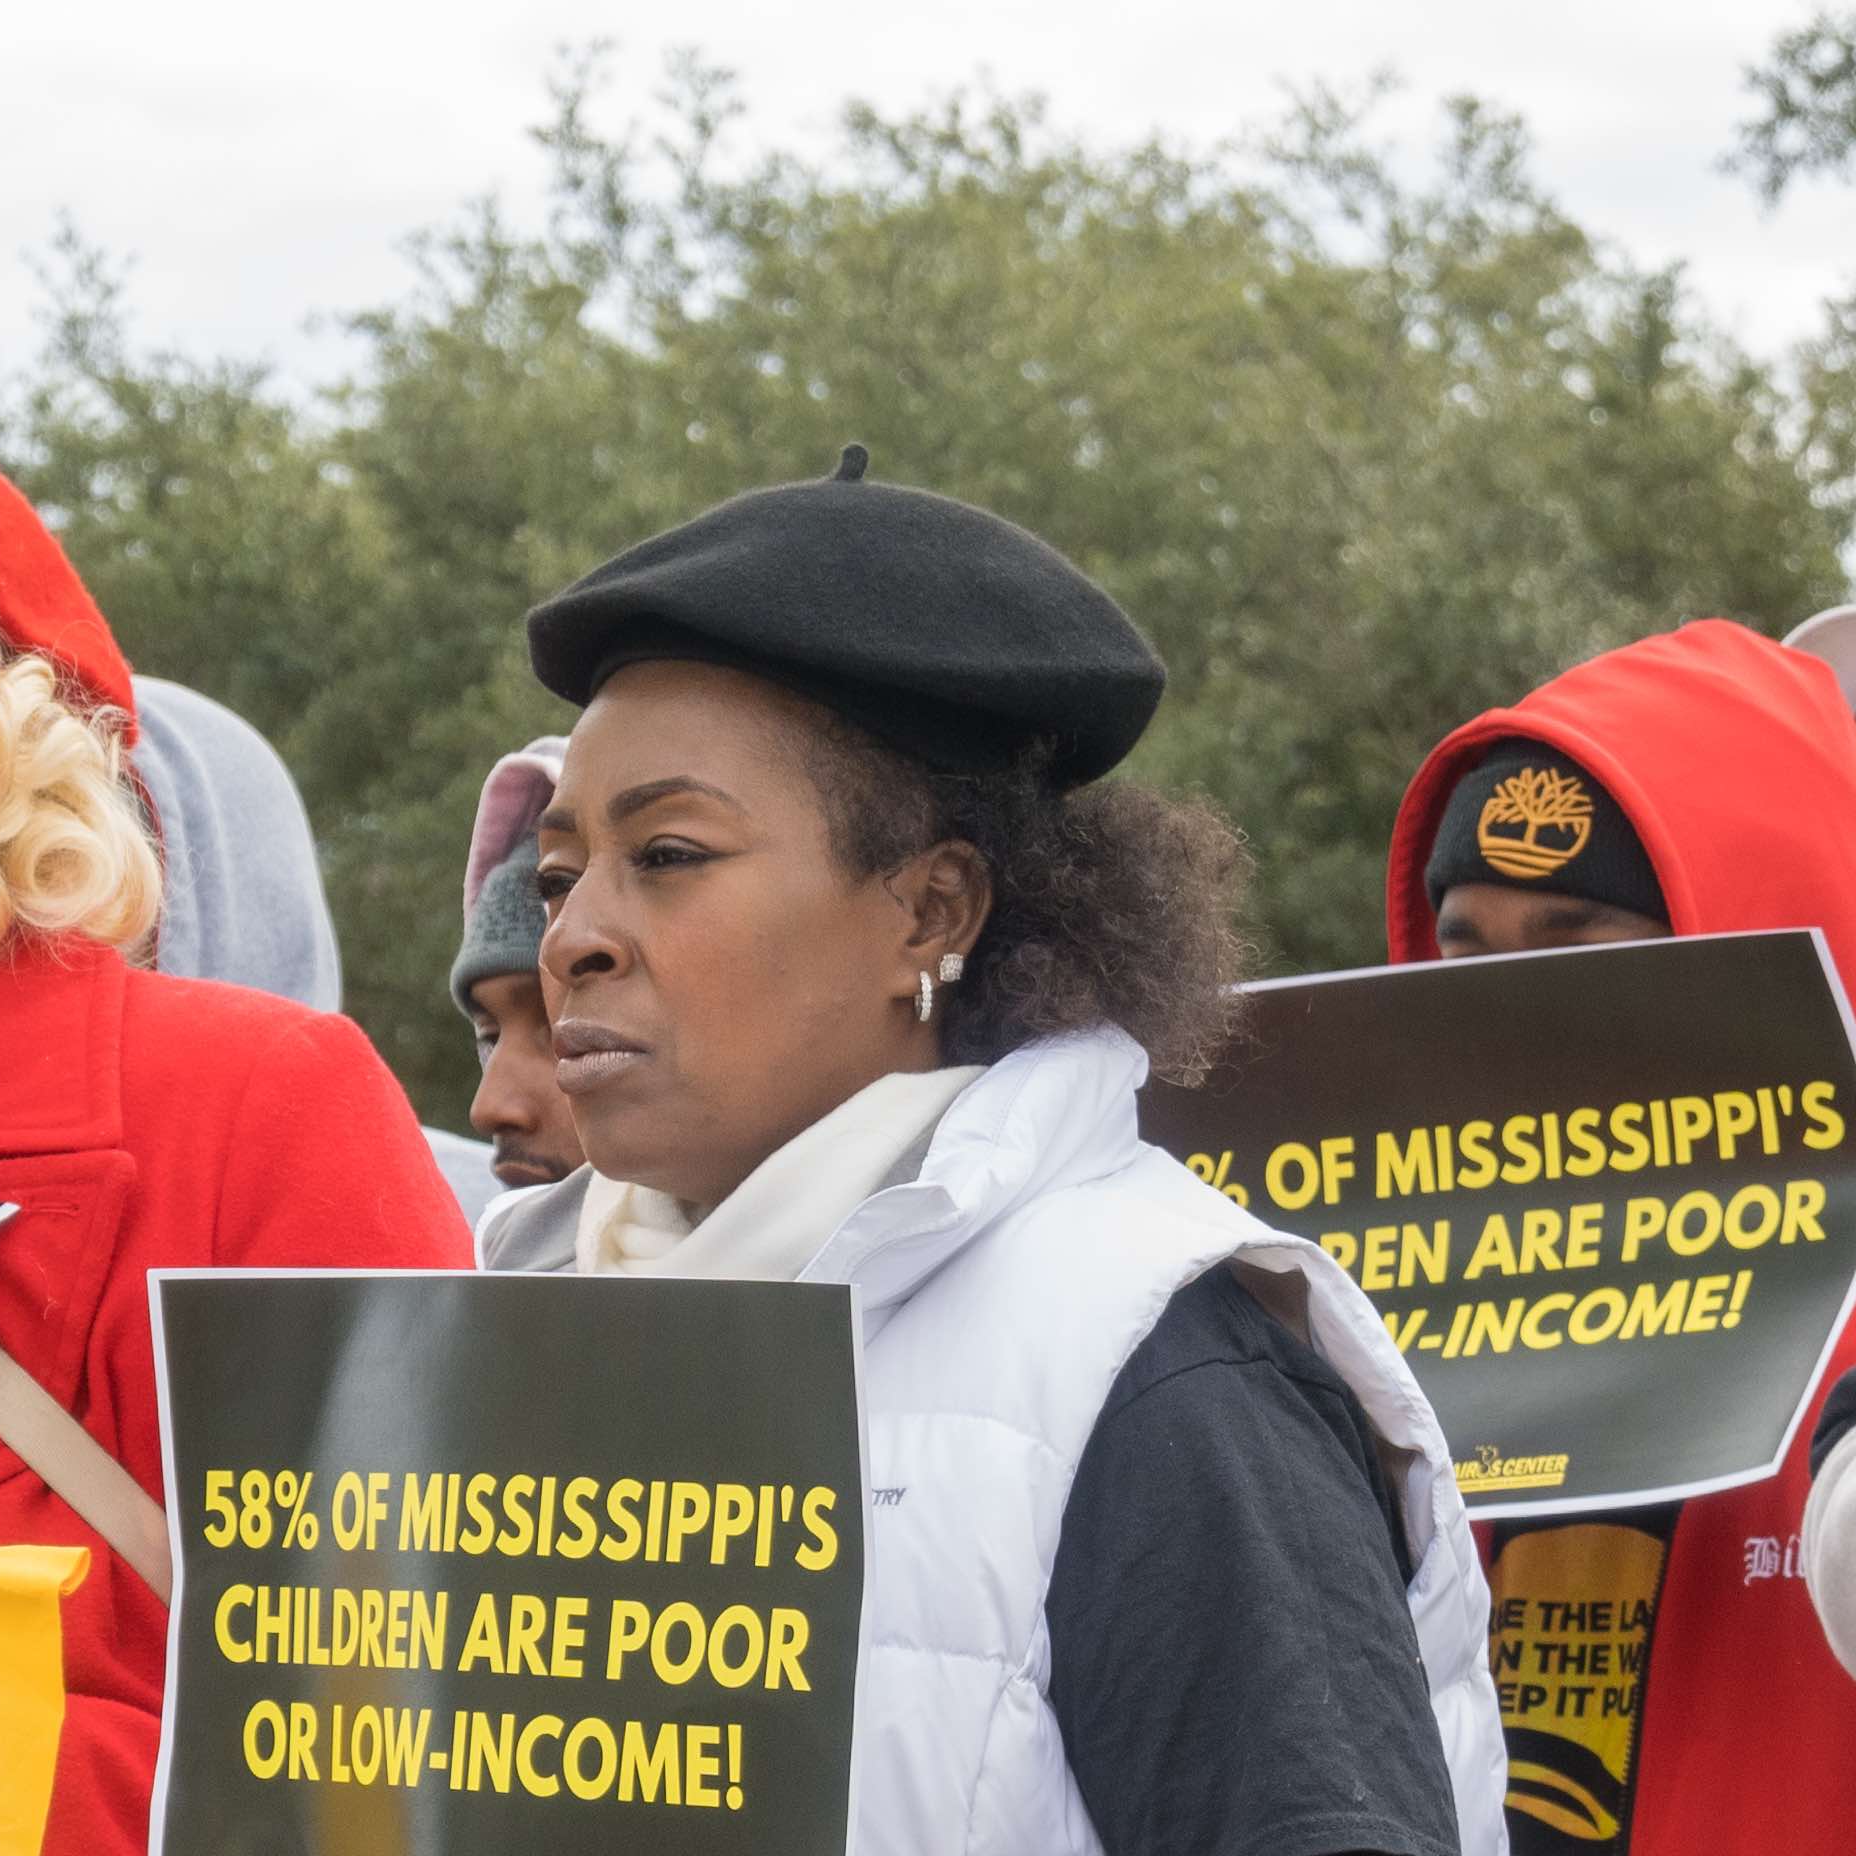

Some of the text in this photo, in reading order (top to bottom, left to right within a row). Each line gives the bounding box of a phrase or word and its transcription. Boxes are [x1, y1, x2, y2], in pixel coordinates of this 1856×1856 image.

[1265, 1136, 1356, 1210] OF
[1375, 1081, 1846, 1199] MISSISSIPPI'S
[1463, 1201, 1602, 1280] ARE
[1620, 1180, 1827, 1263] POOR
[1503, 1453, 1570, 1476] CENTER
[202, 1469, 839, 1571] 58% OF MISSISSIPPI'S
[214, 1584, 812, 1692] CHILDREN ARE POOR
[1533, 1641, 1611, 1675] THE
[1537, 1600, 1613, 1632] THE
[1555, 1684, 1596, 1717] IT
[242, 1699, 745, 1810] OR LOW-INCOME!
